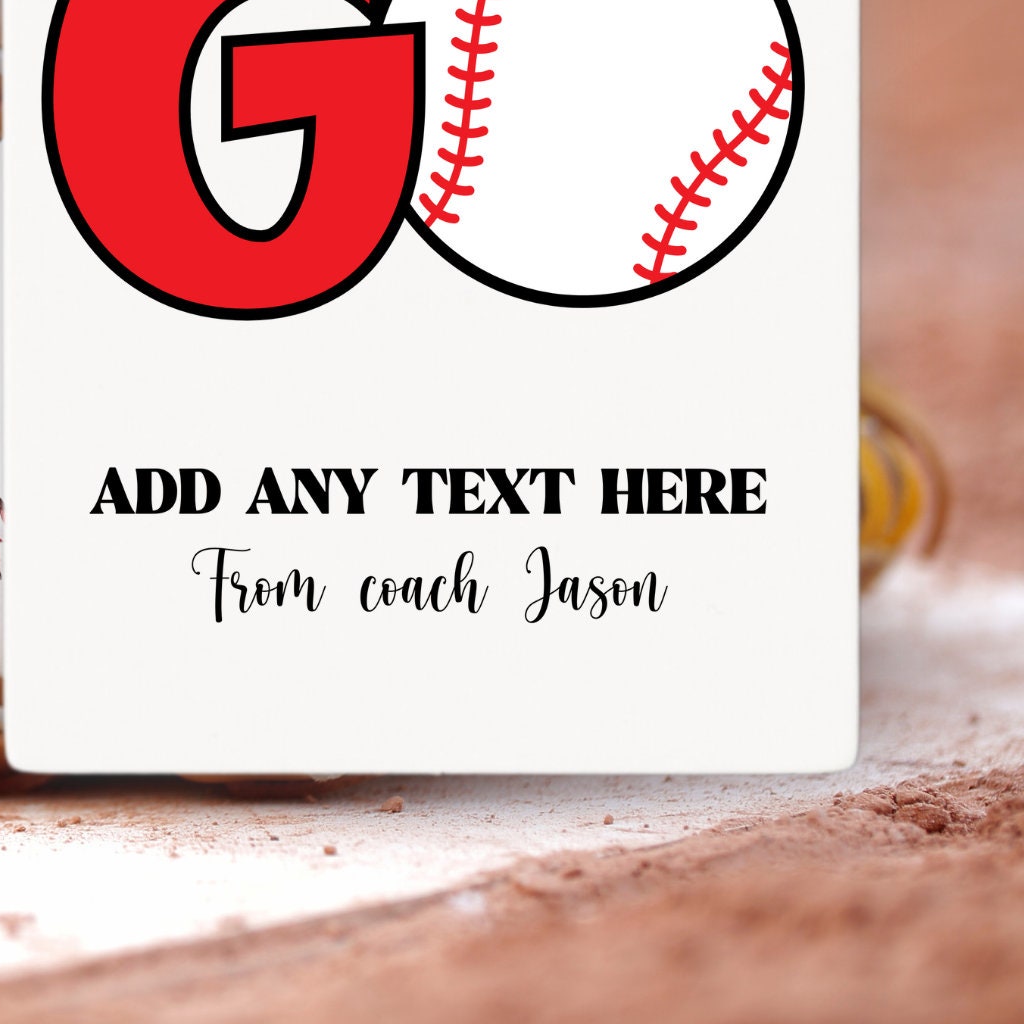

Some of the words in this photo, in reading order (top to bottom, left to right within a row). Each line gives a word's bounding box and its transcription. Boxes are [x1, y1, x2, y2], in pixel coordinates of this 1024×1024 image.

[90, 467, 221, 515] ADD
[245, 467, 379, 515] ANY
[402, 468, 575, 515] TEXT
[601, 468, 767, 515] HERE
[191, 547, 327, 623] From
[359, 550, 489, 614] coach
[524, 546, 668, 624] Jason
